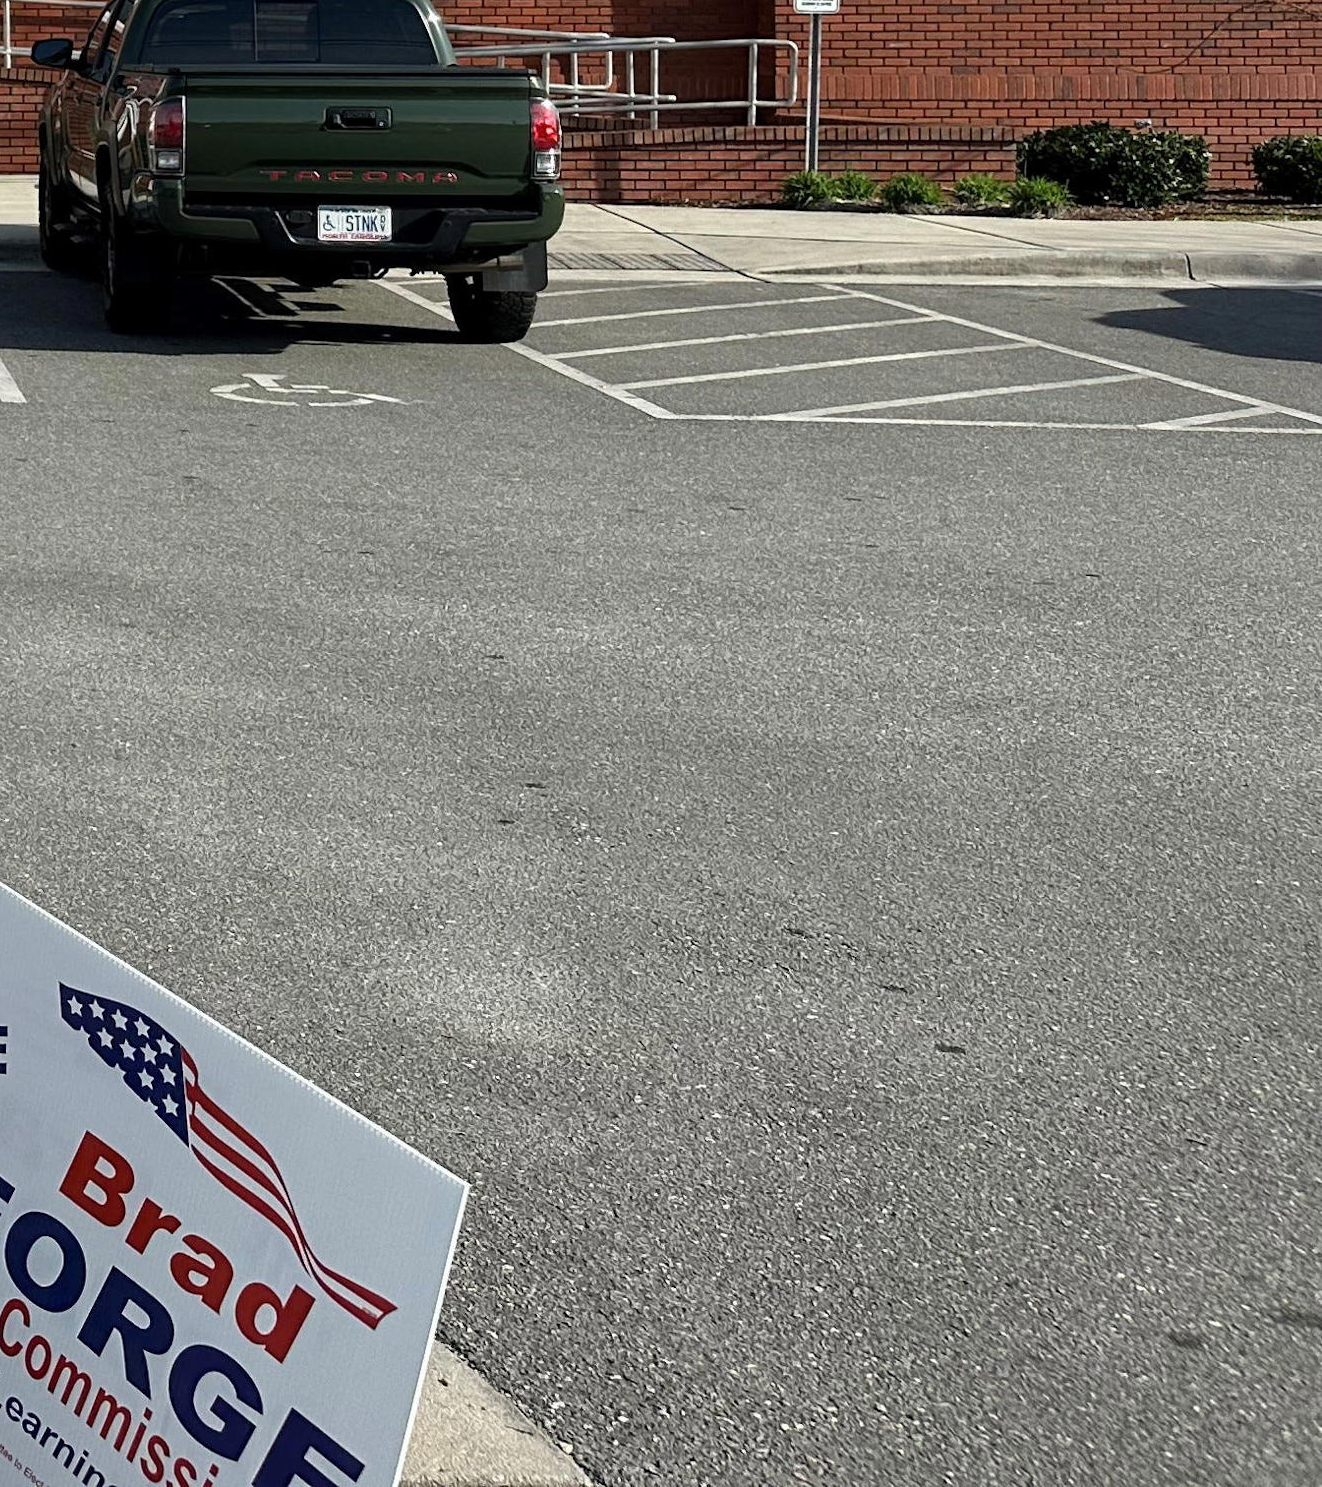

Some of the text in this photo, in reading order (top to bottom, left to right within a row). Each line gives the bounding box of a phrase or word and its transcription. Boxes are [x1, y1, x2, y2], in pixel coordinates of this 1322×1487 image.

[259, 170, 458, 183] TACOMA
[59, 1129, 316, 1365] Brad
[14, 1458, 24, 1472] to
